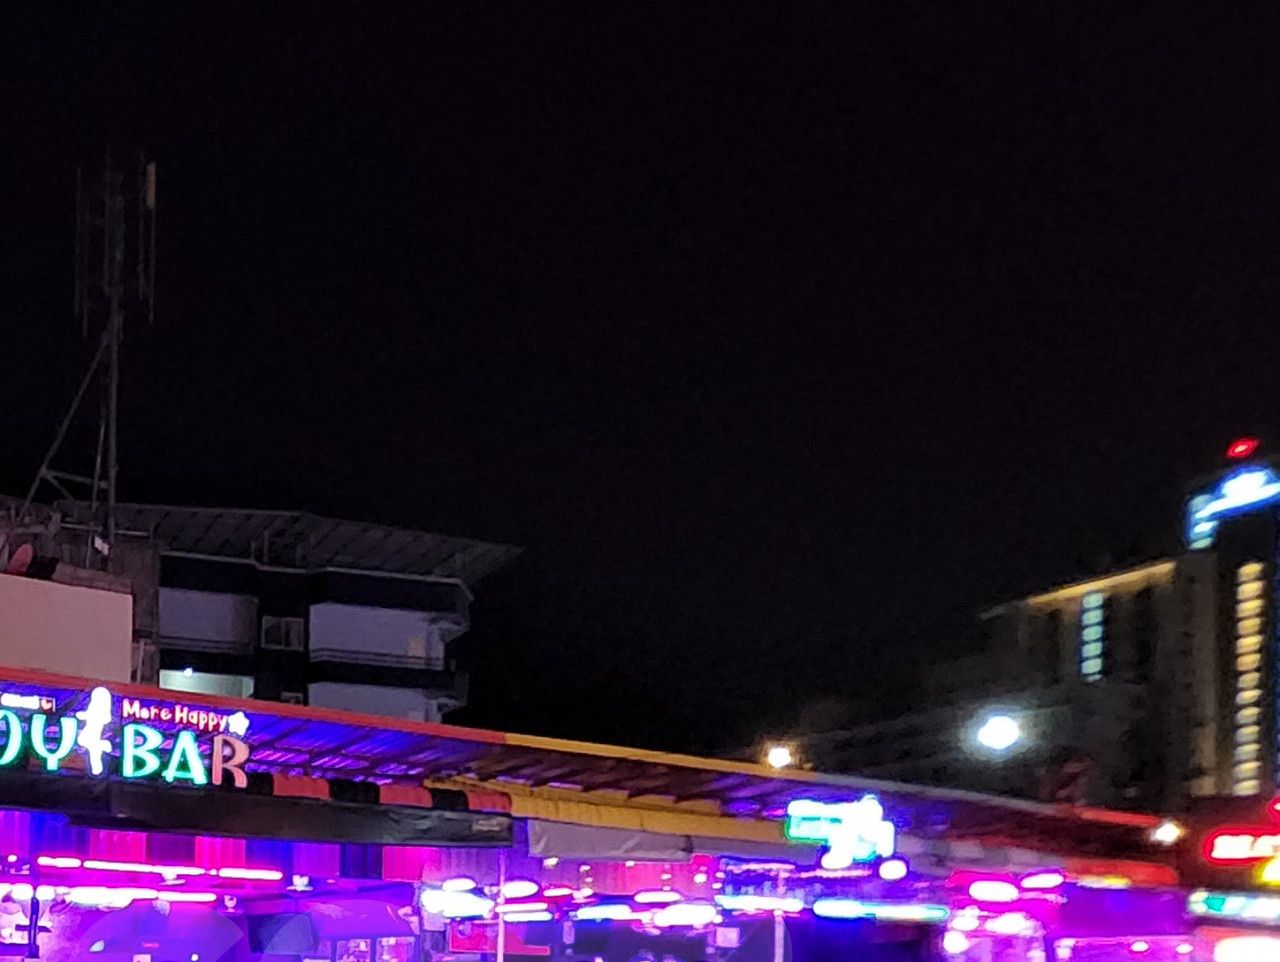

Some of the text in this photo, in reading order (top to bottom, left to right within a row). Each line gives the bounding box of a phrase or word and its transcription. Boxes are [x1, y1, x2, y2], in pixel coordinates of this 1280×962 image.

[122, 698, 228, 732] More Happy
[122, 722, 250, 788] BAR
